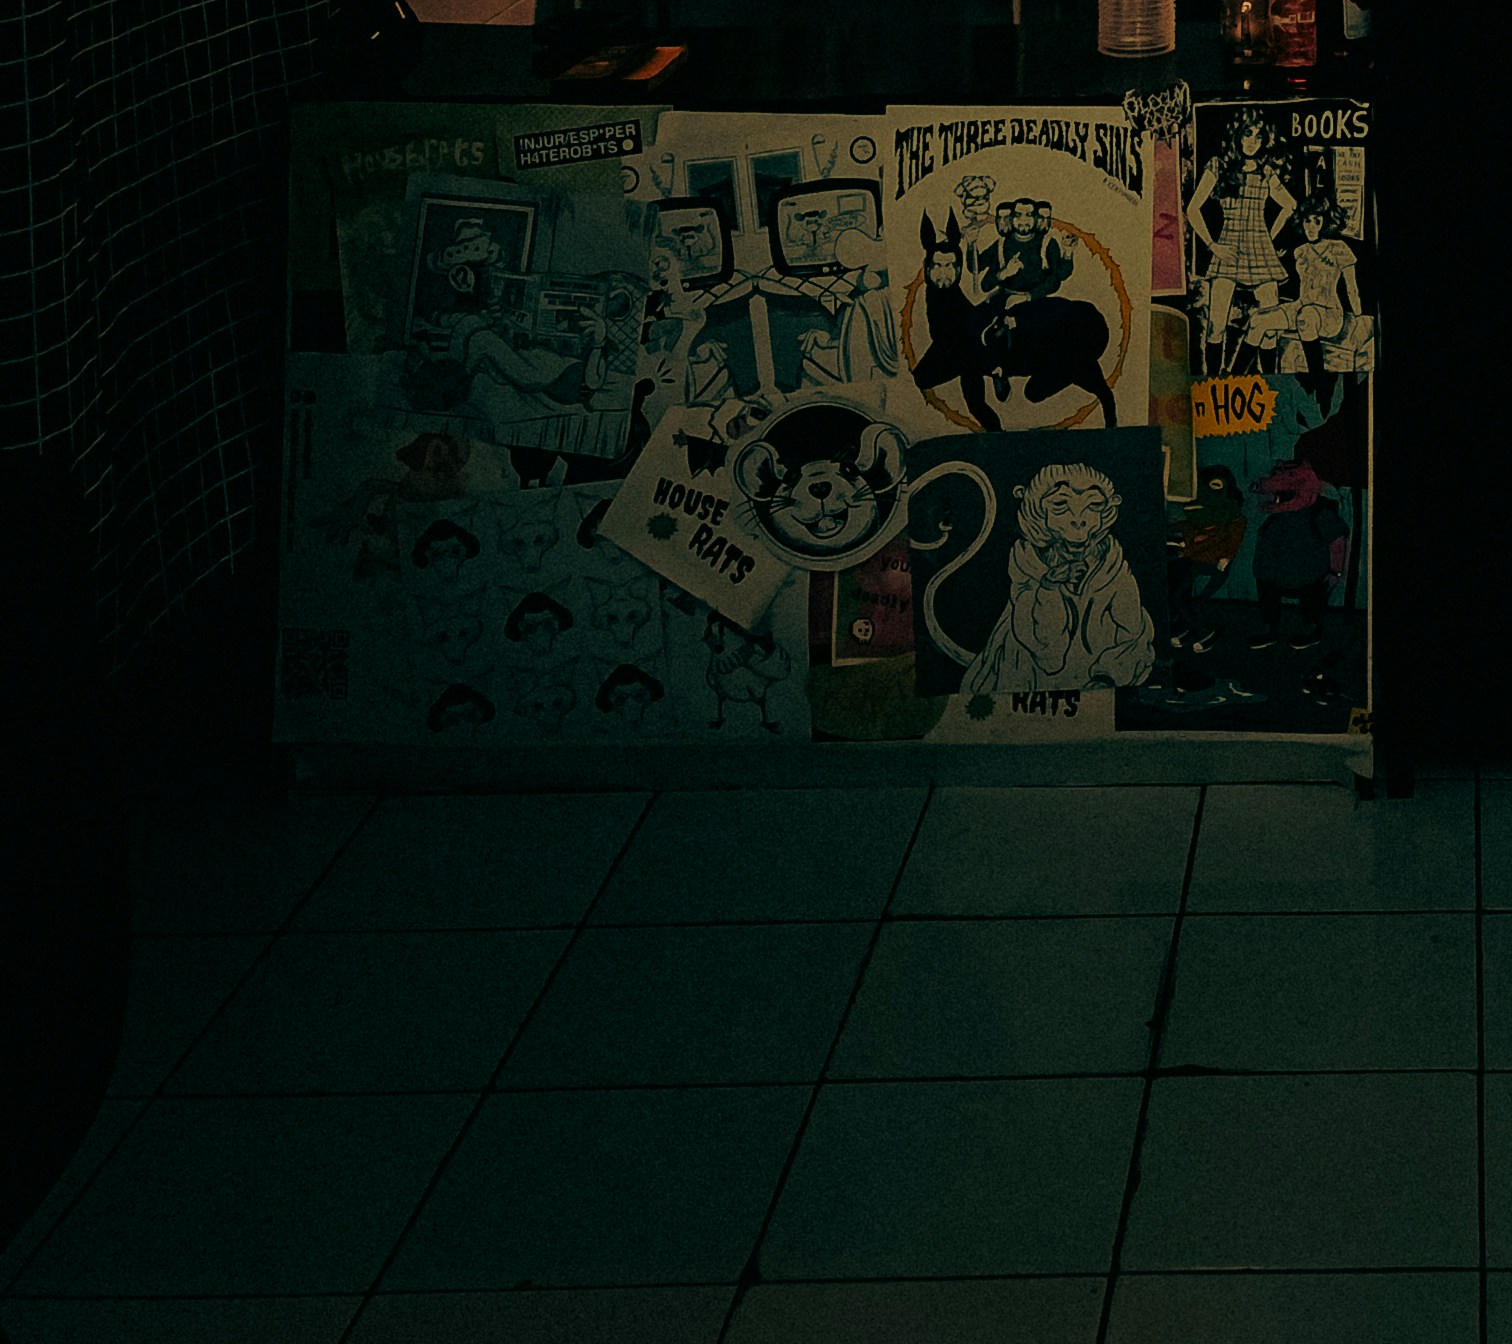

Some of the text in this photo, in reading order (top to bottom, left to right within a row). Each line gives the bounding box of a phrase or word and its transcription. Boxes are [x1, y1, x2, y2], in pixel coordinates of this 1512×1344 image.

[1291, 109, 1370, 139] BOOKS
[894, 124, 934, 200] THE
[938, 119, 1006, 166] THREE
[1010, 118, 1089, 163] DEADLY
[1093, 122, 1143, 200] SINS
[1211, 381, 1266, 425] HOG
[653, 477, 730, 525] HOUSE
[688, 523, 755, 584] RATS
